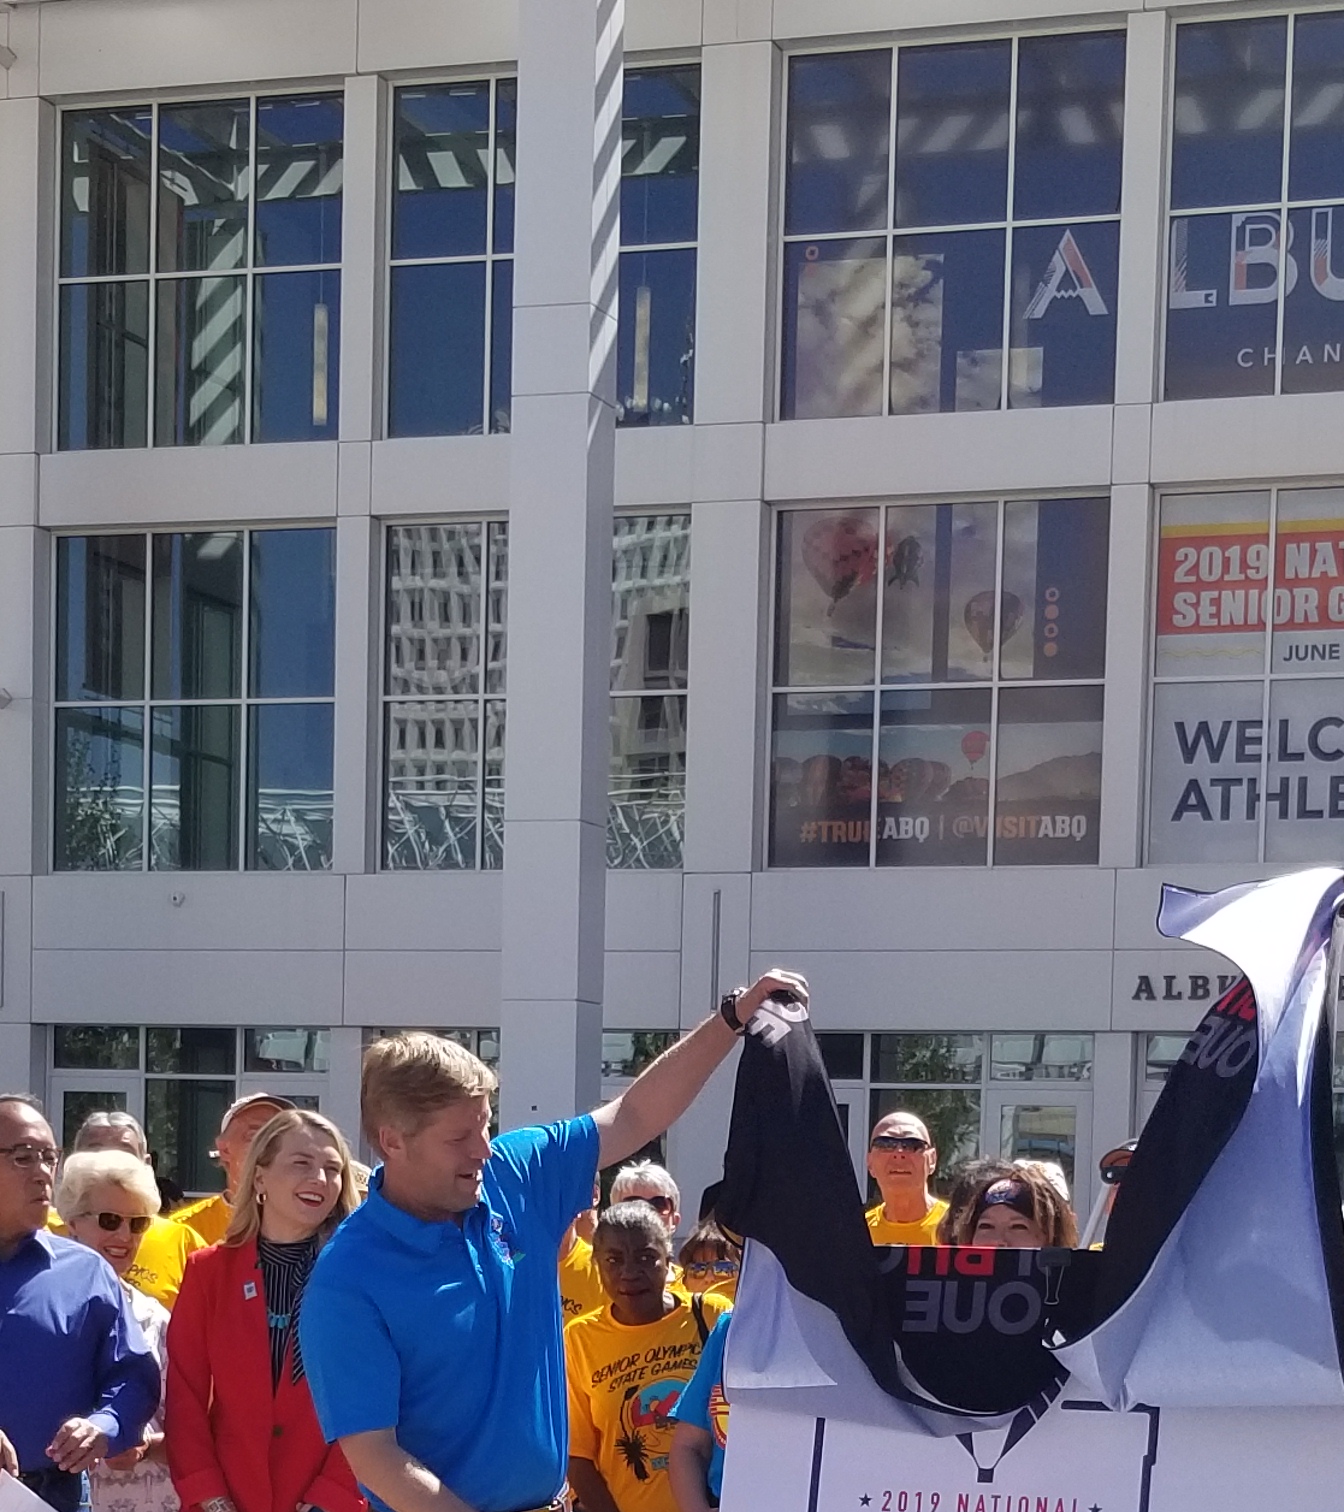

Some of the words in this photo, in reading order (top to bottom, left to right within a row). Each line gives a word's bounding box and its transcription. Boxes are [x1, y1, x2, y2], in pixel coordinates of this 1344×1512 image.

[1173, 544, 1271, 583] 2019
[1172, 588, 1319, 627] SENIOR
[1282, 644, 1341, 661] JUNE
[592, 1353, 640, 1388] SENIOR
[608, 1365, 646, 1393] STATE
